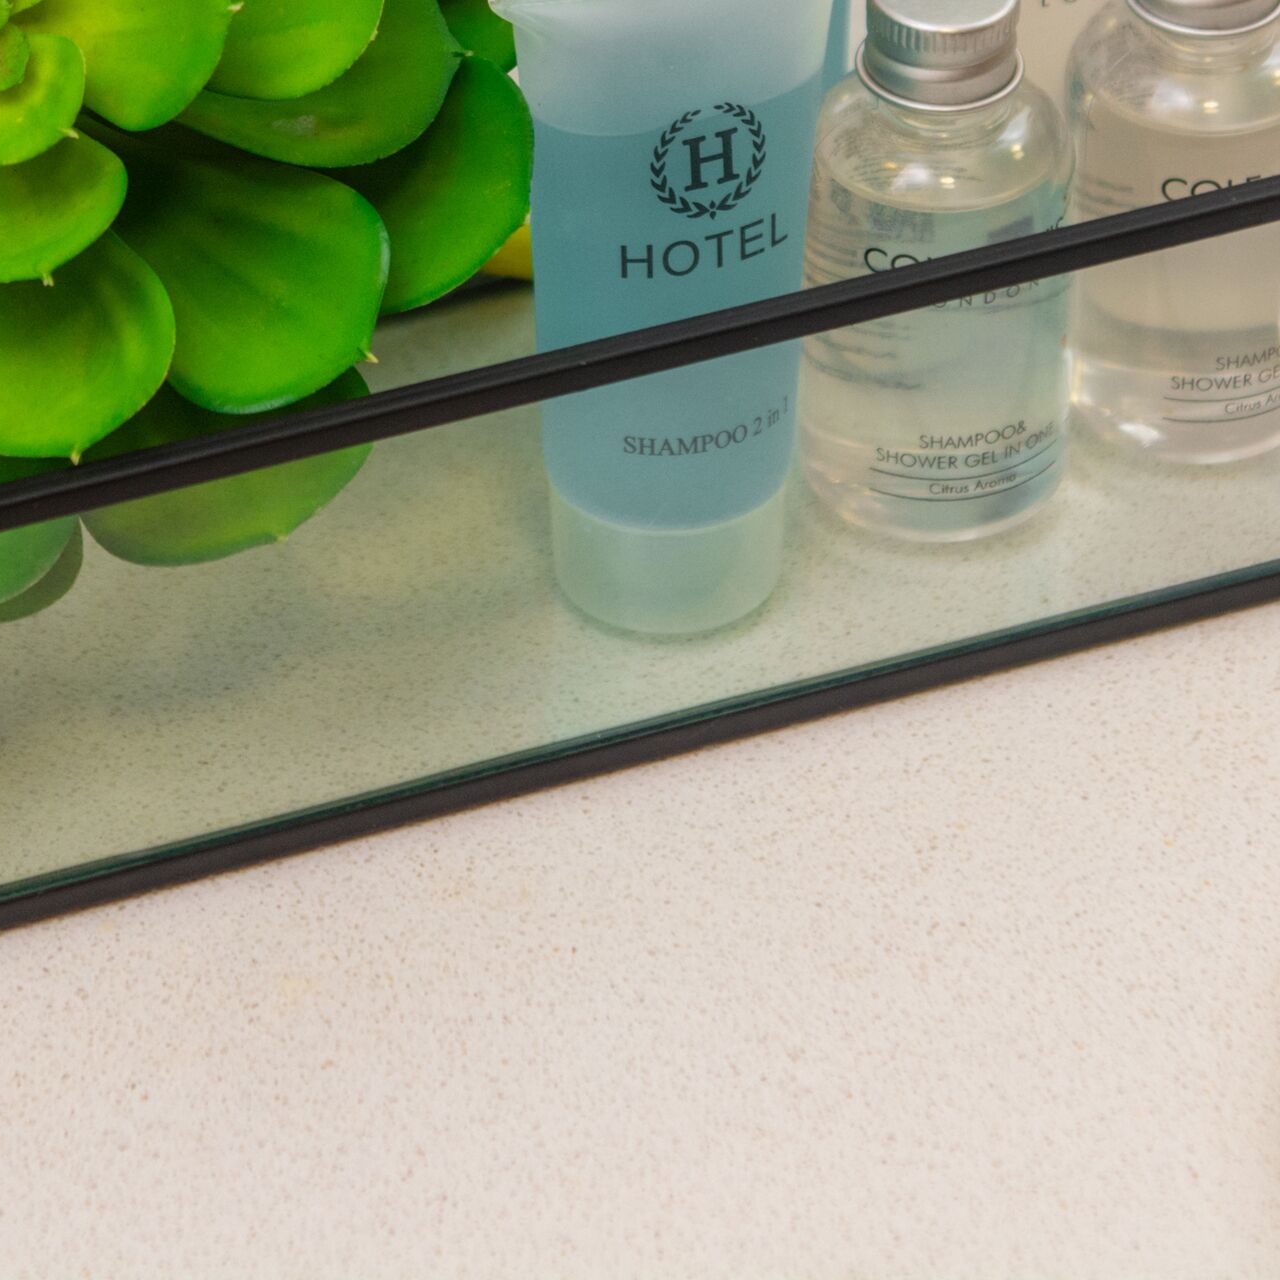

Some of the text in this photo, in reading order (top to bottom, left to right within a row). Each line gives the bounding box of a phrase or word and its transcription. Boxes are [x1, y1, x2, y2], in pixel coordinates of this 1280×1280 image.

[683, 127, 740, 191] H
[621, 212, 788, 279] HOTEL
[1170, 374, 1253, 392] SHOWER
[623, 424, 748, 456] SHAMPOO
[752, 416, 763, 437] 2
[767, 408, 780, 428] in
[875, 422, 1054, 470] SHOWER GEL IN ONE
[928, 473, 1017, 496] Citrus Aroma
